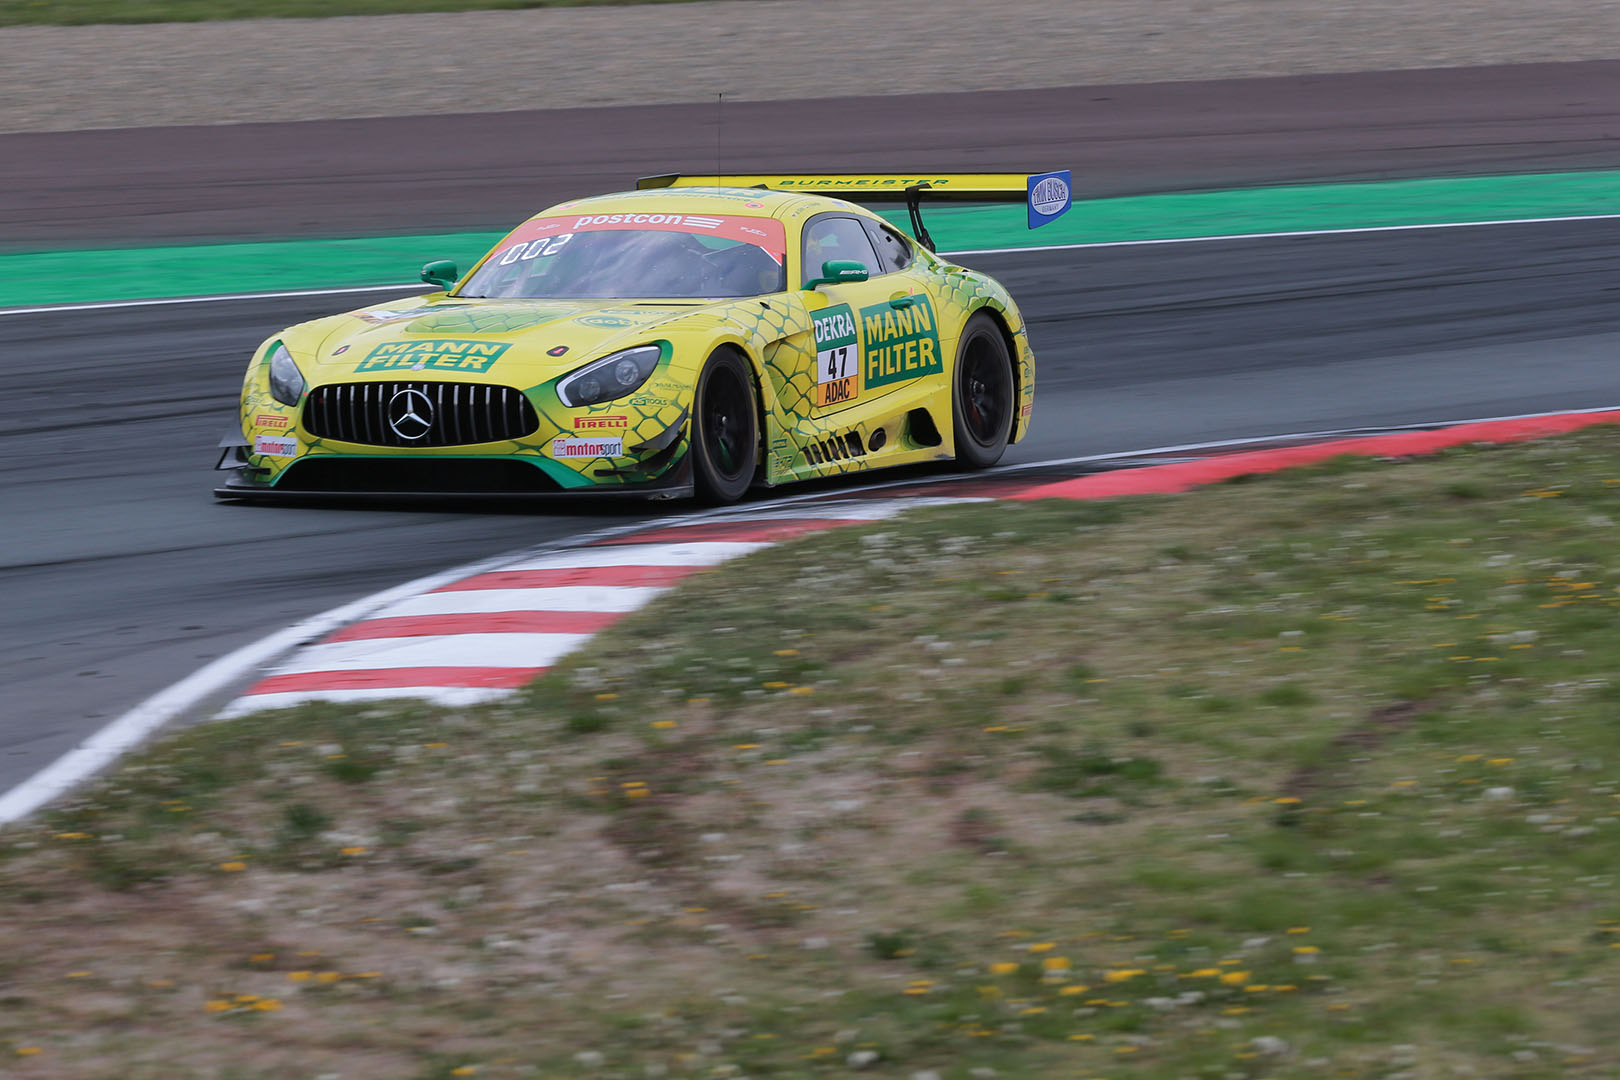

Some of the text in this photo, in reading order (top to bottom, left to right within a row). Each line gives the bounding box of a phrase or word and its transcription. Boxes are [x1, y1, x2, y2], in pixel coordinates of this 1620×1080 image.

[573, 213, 682, 229] postcon
[500, 233, 574, 265] 002
[814, 312, 856, 344] DEKRA
[865, 303, 932, 345] MANN
[363, 353, 489, 369] FILTER
[375, 342, 502, 356] MANN
[868, 337, 937, 380] FILTER
[828, 347, 847, 379] 47
[825, 378, 850, 404] ADAC
[255, 414, 288, 428] PIRELLI
[574, 415, 628, 429] PIRELLI
